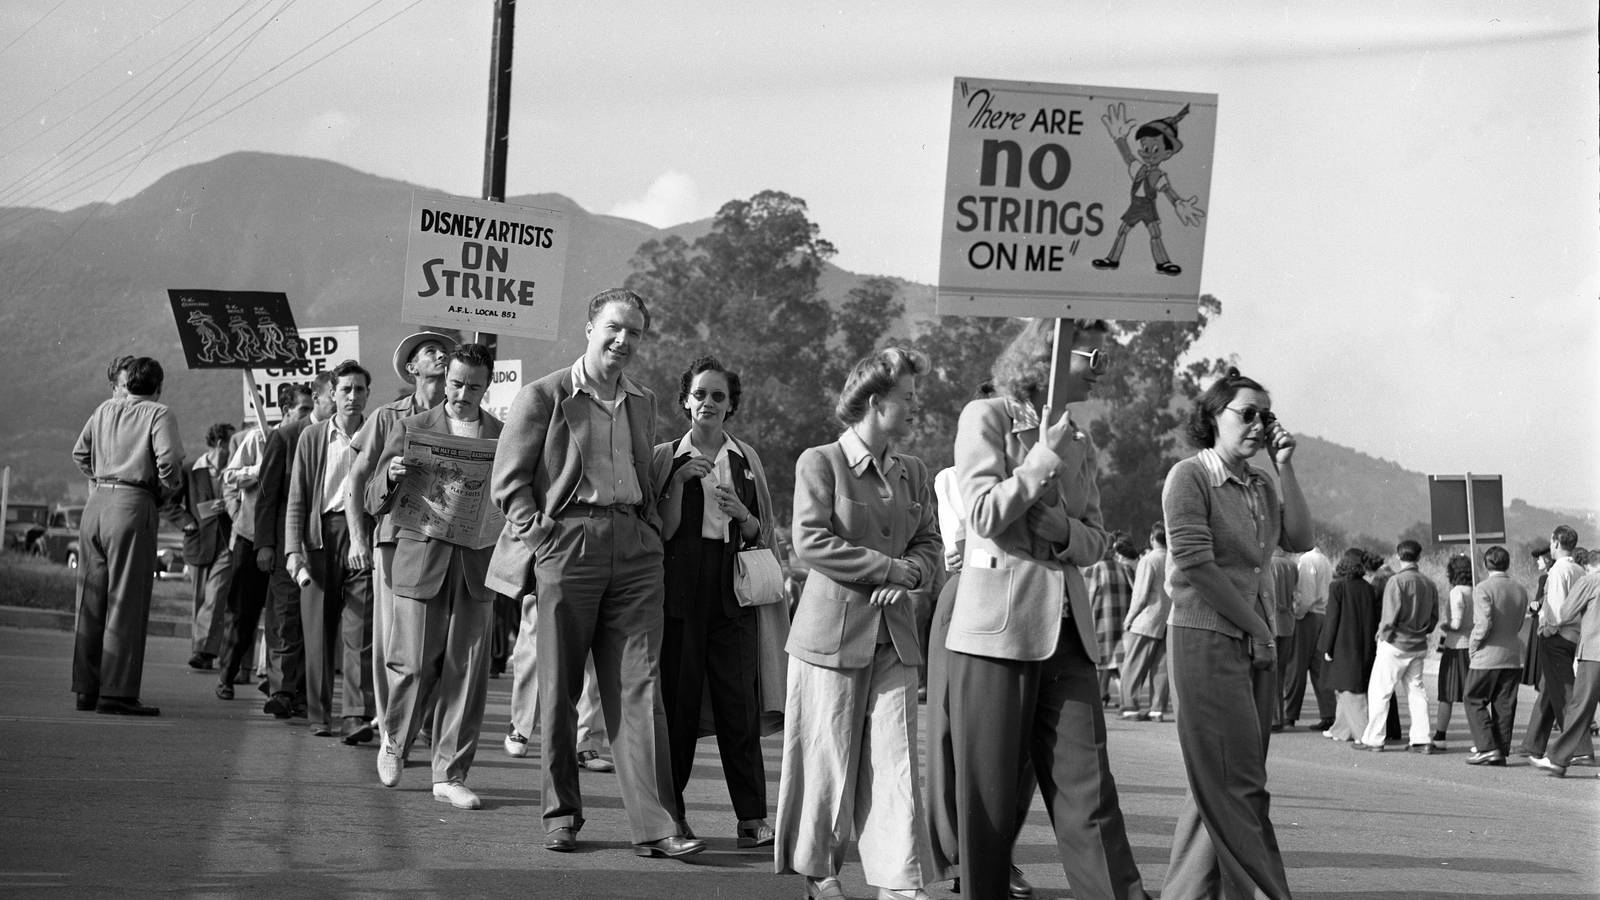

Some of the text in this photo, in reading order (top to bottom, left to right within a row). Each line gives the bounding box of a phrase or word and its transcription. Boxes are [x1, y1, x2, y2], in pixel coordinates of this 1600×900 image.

[1029, 108, 1084, 135] ARE
[421, 208, 554, 249] DISNEY ARTISTS
[461, 241, 509, 273] ON
[968, 241, 1018, 270] ON
[417, 258, 536, 307] STRIKE
[475, 308, 499, 317] LOCAL
[501, 311, 517, 319] 852
